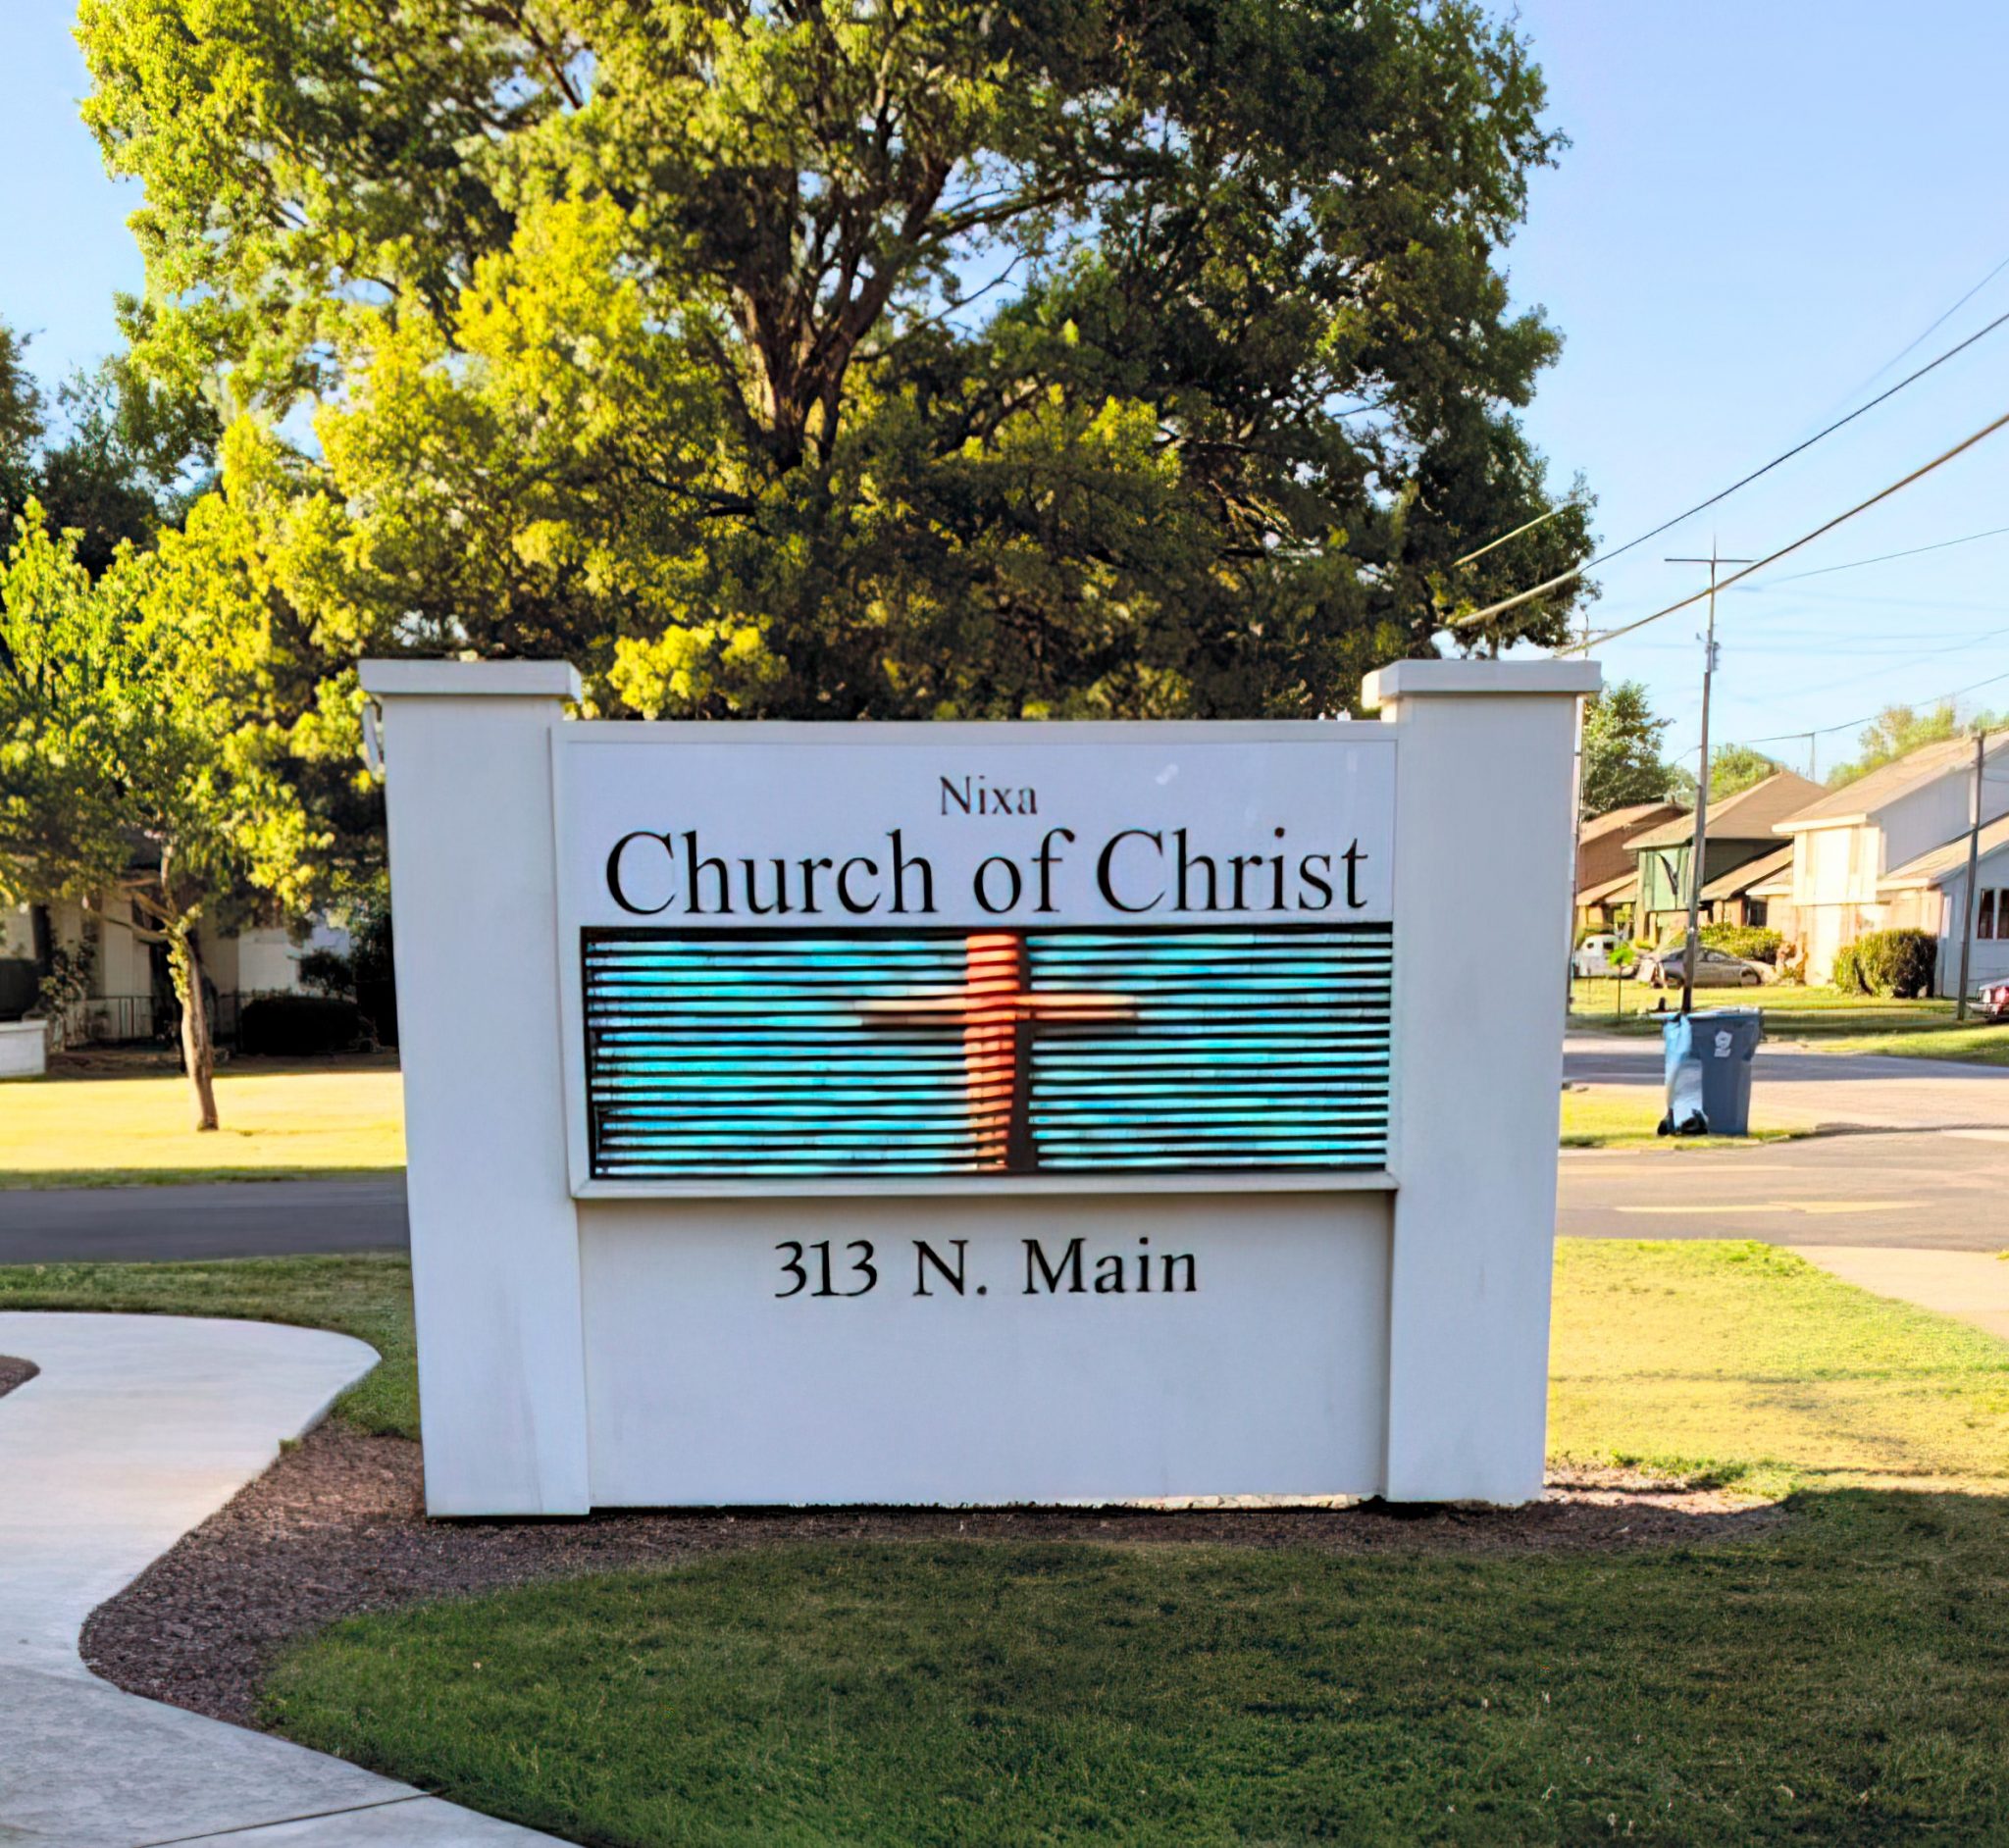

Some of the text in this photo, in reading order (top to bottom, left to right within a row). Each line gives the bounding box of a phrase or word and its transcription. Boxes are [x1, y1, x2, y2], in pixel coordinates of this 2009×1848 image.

[940, 774, 1040, 817] Nixa
[606, 826, 1369, 916] Church of Christ
[774, 1235, 1198, 1299] 313 N. Main
